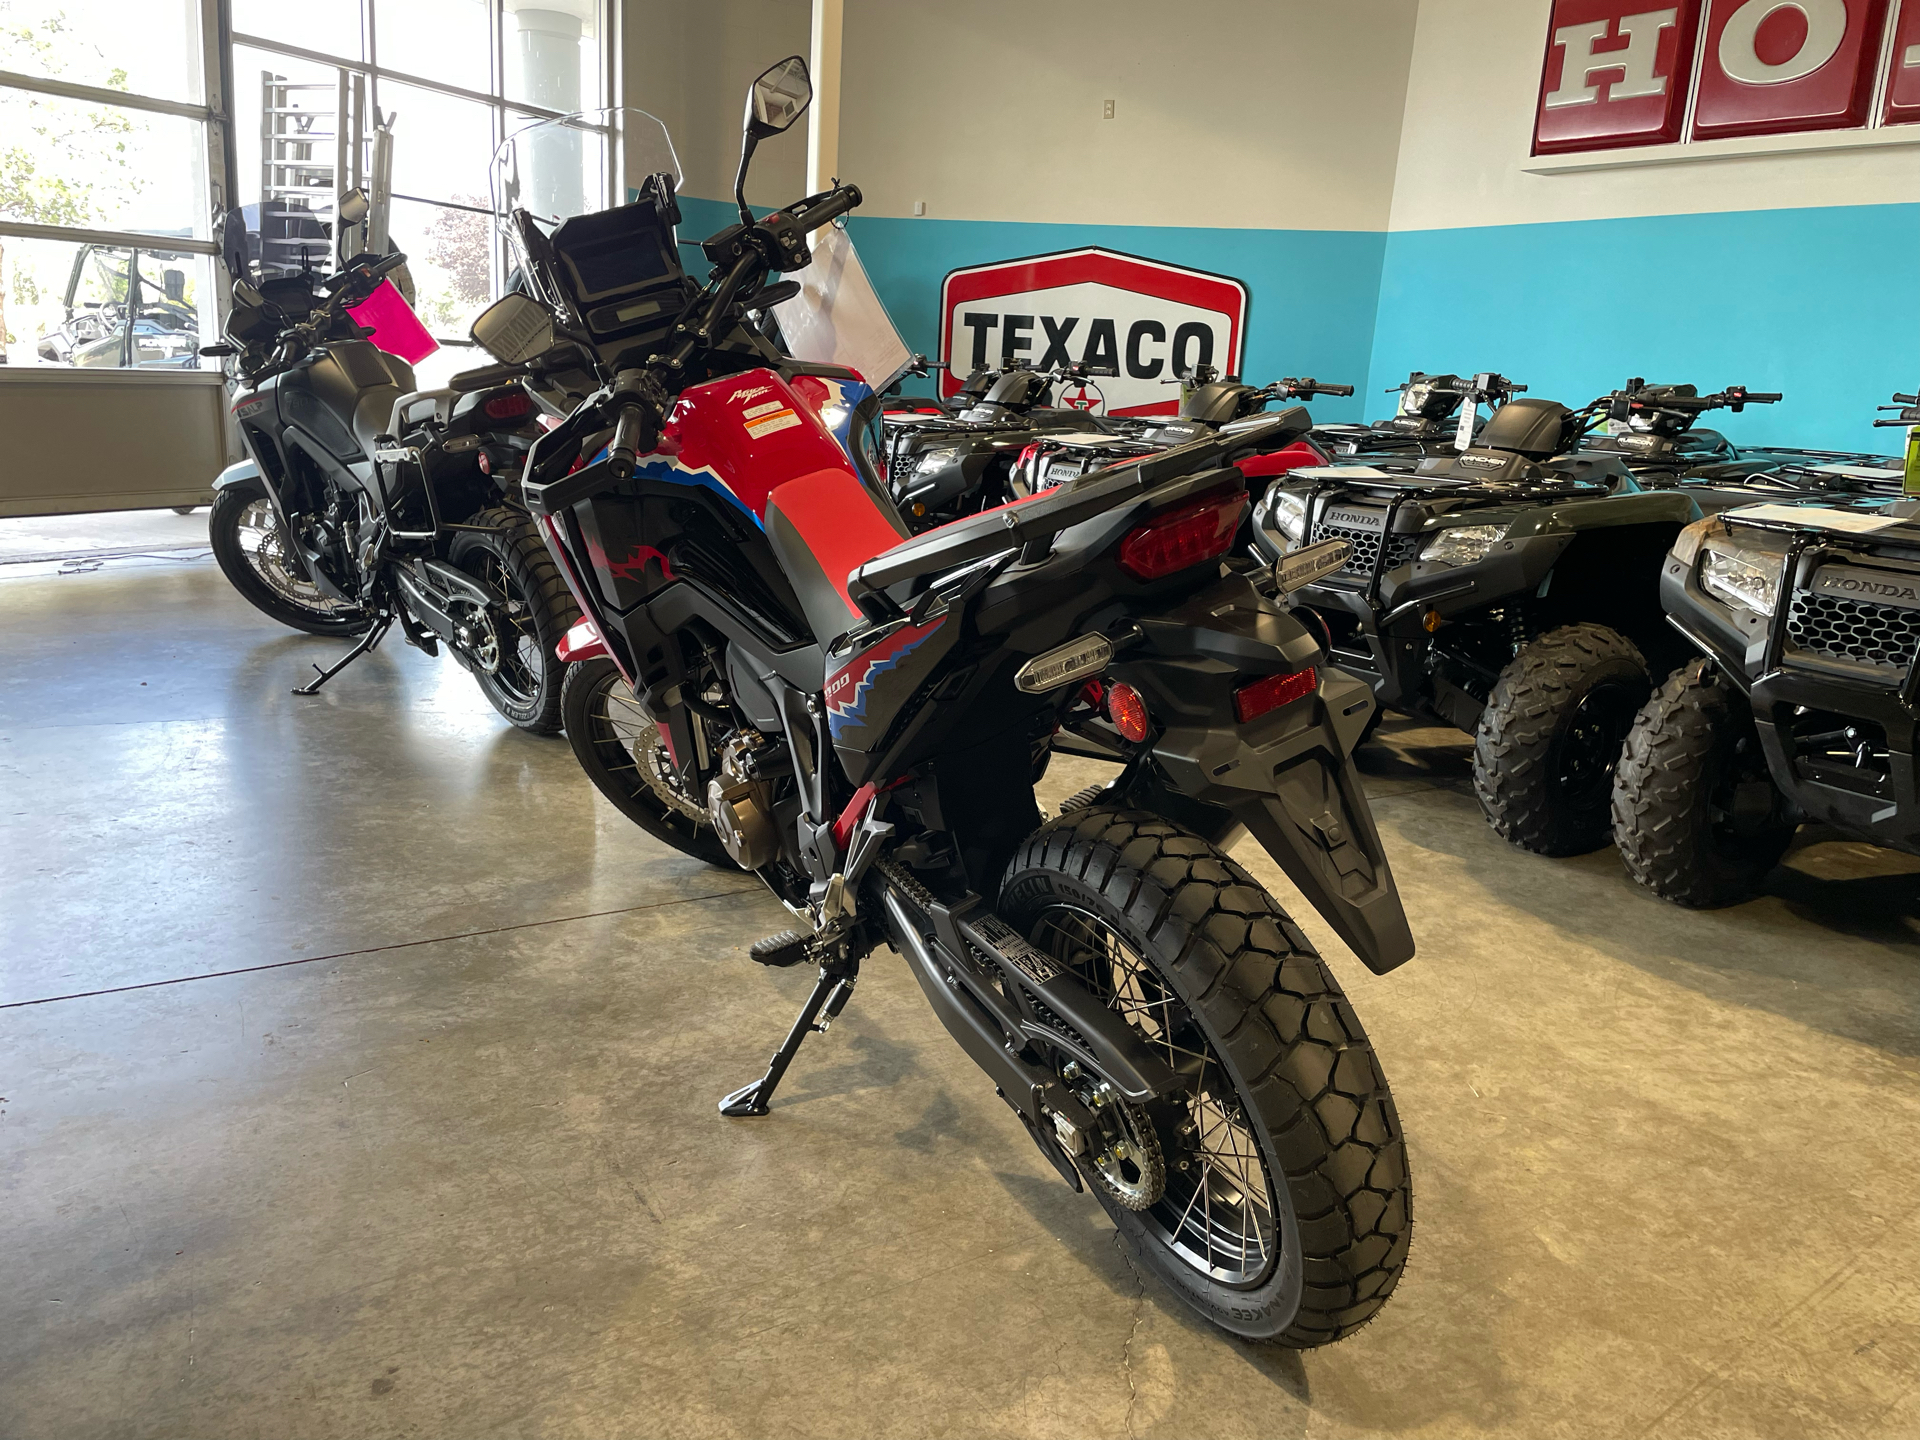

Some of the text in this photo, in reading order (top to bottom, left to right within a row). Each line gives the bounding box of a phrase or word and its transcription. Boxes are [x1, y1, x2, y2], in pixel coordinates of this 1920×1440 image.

[1545, 0, 1920, 110] HO
[964, 312, 1213, 379] TEXACO
[1617, 437, 1654, 447] RUBICON
[1459, 454, 1507, 467] RANCHER
[1329, 511, 1381, 527] HONDA
[1822, 575, 1919, 600] HONDA
[1058, 883, 1106, 914] 150/70
[1231, 1291, 1285, 1321] ANAKEE
